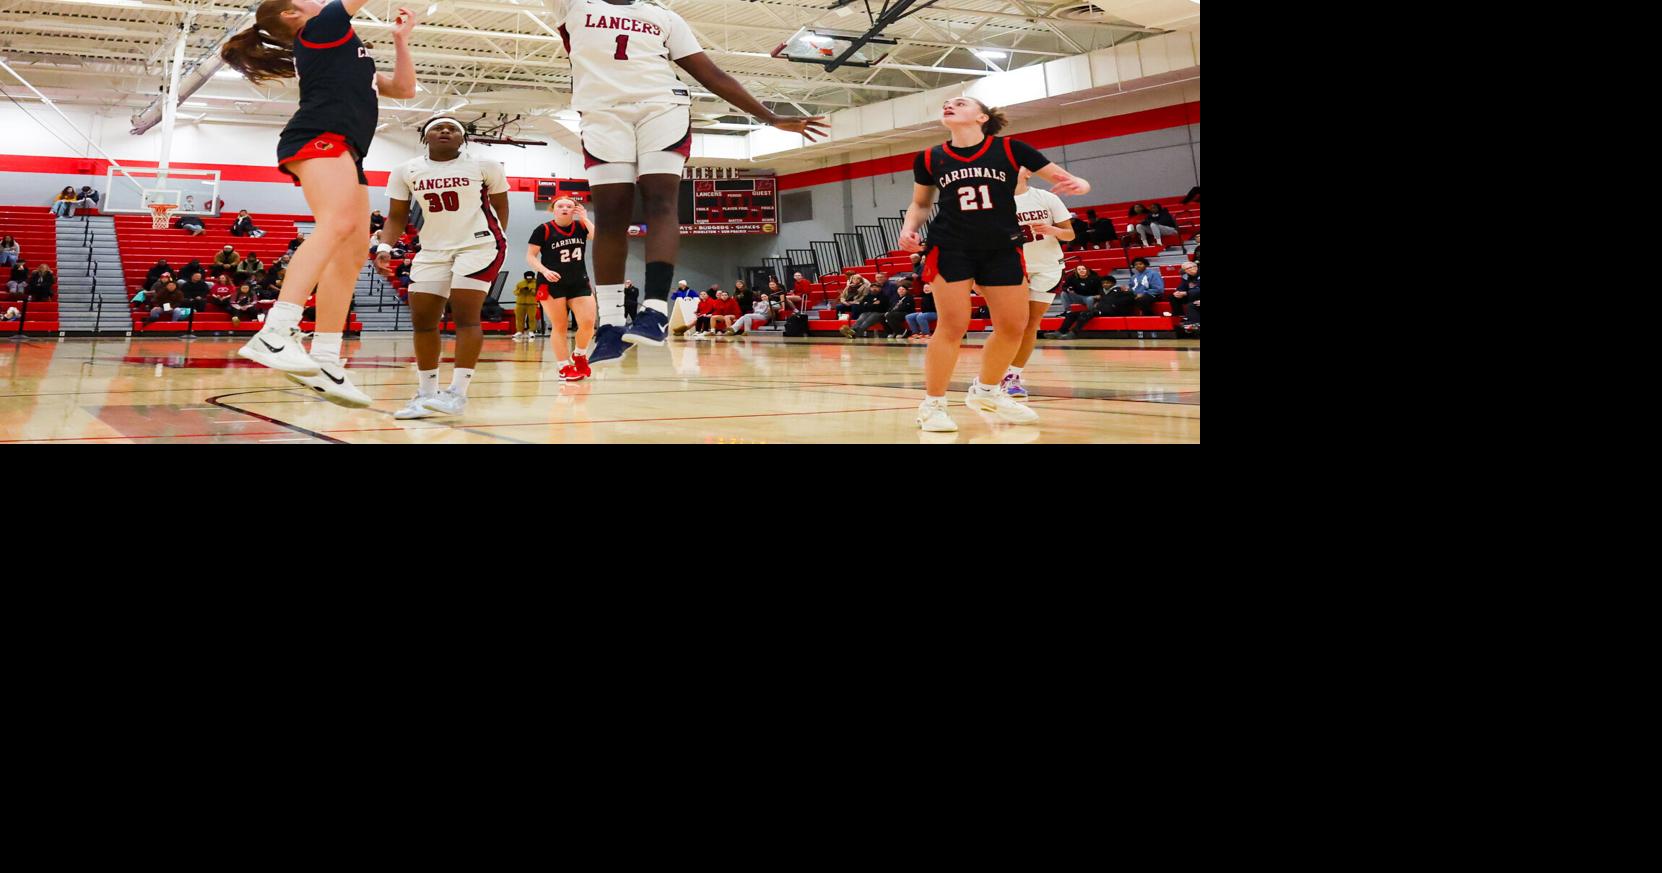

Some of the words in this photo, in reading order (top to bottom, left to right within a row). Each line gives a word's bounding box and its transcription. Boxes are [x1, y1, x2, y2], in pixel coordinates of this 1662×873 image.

[584, 14, 662, 36] LANCERS
[614, 34, 630, 61] 1
[412, 177, 471, 191] LANCERS
[683, 167, 739, 180] LLETTE
[939, 167, 1007, 188] CARDINALS
[423, 190, 460, 213] 30
[957, 184, 994, 211] 21
[1016, 210, 1050, 223] NCERS
[560, 247, 582, 263] 24
